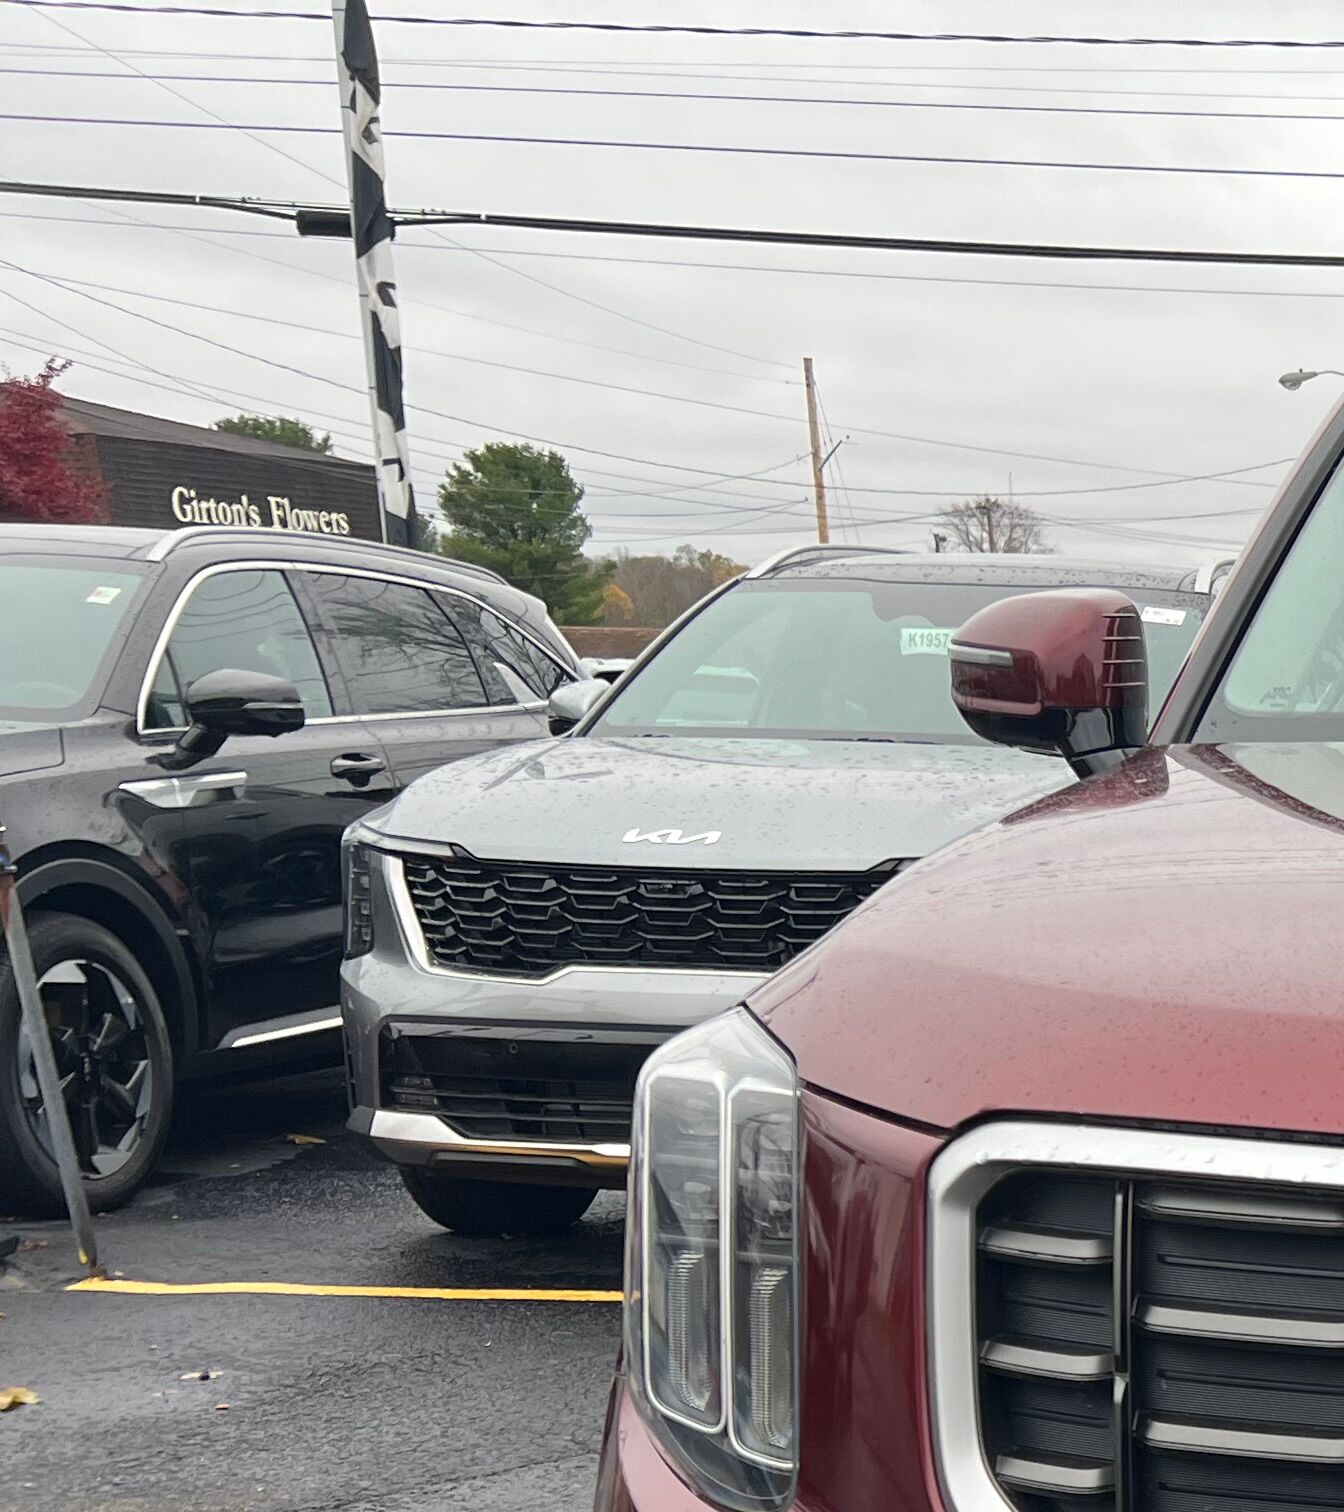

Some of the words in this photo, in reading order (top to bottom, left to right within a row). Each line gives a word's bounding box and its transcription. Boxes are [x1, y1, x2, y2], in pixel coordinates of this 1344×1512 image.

[171, 486, 262, 527] Girton's
[267, 496, 350, 535] Flowers
[908, 632, 950, 649] K1957
[621, 828, 722, 846] KIA
